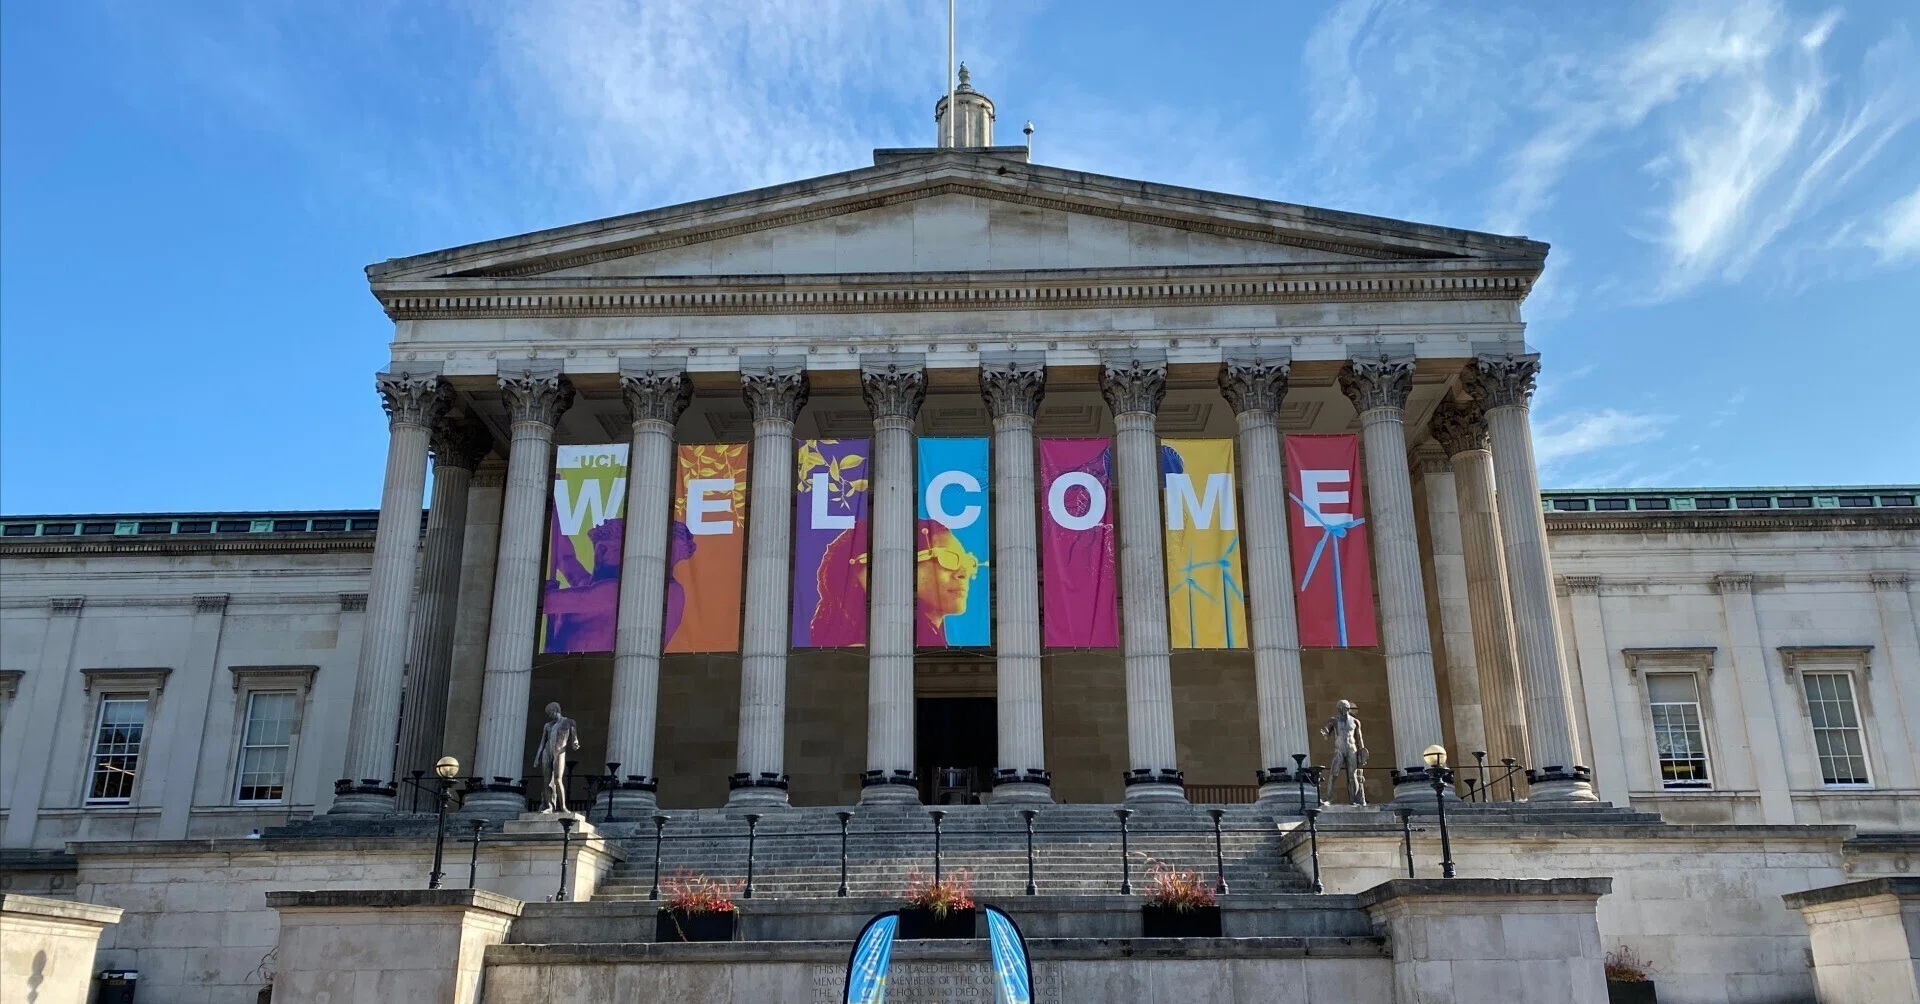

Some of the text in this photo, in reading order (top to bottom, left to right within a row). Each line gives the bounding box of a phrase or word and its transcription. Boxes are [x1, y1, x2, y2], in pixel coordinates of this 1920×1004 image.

[580, 453, 620, 468] UCL
[813, 965, 834, 974] THIS
[904, 964, 938, 973] PLACED
[940, 963, 961, 973] HERE
[813, 977, 846, 986] MEMO
[891, 976, 935, 986] MEMBERS
[954, 976, 972, 985] THE
[812, 989, 833, 998] THE
[884, 988, 925, 998] SCHOOL
[927, 988, 952, 997] WHO
[956, 987, 979, 997] DIED
